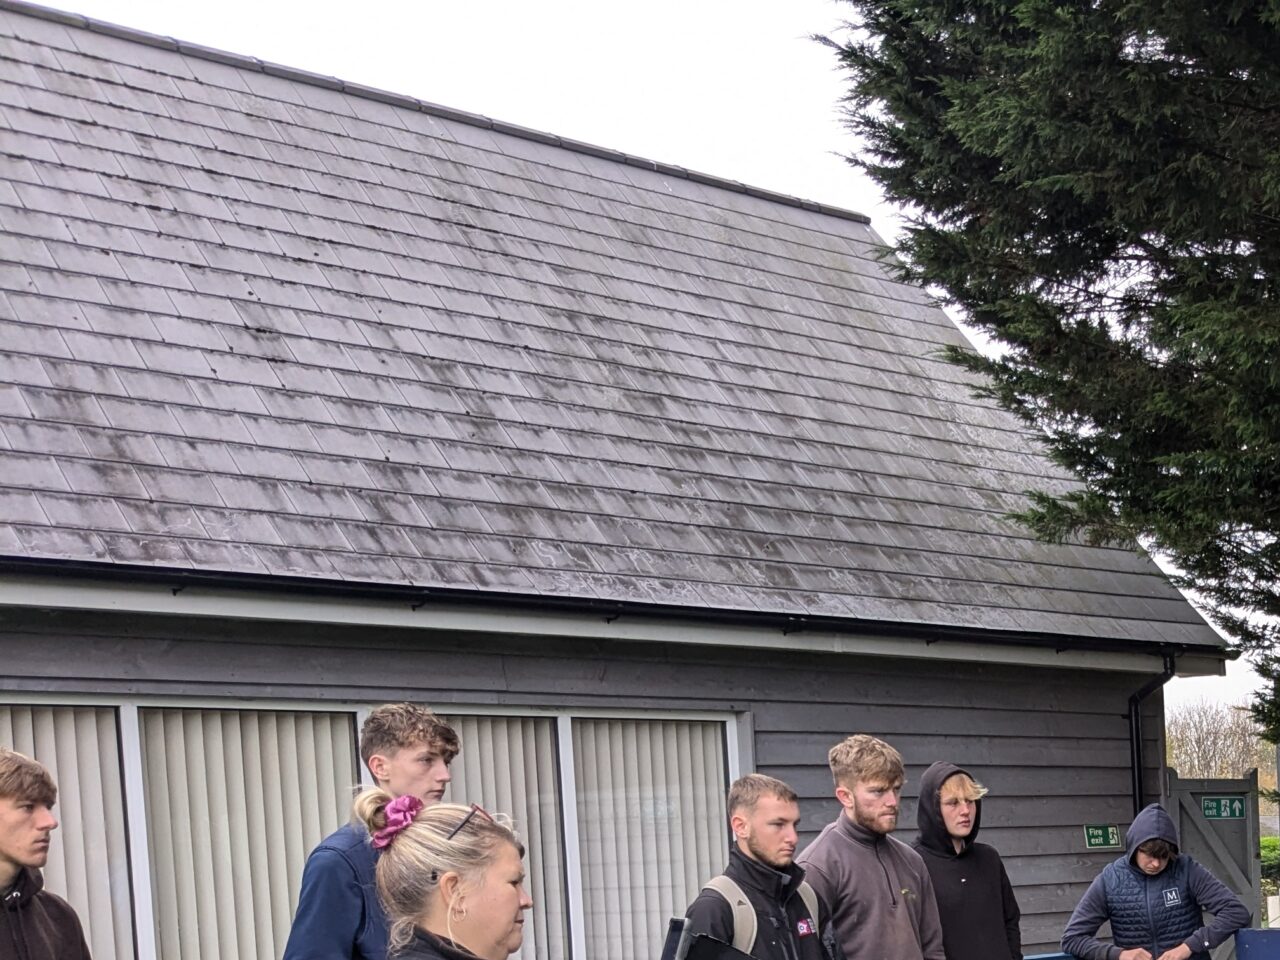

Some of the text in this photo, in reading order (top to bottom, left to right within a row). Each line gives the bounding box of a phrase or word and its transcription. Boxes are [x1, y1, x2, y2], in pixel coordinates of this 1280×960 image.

[1204, 800, 1217, 808] Fire
[1204, 808, 1217, 816] exit
[1089, 828, 1103, 836] Fire
[1091, 836, 1103, 844] exit
[1166, 890, 1177, 901] M
